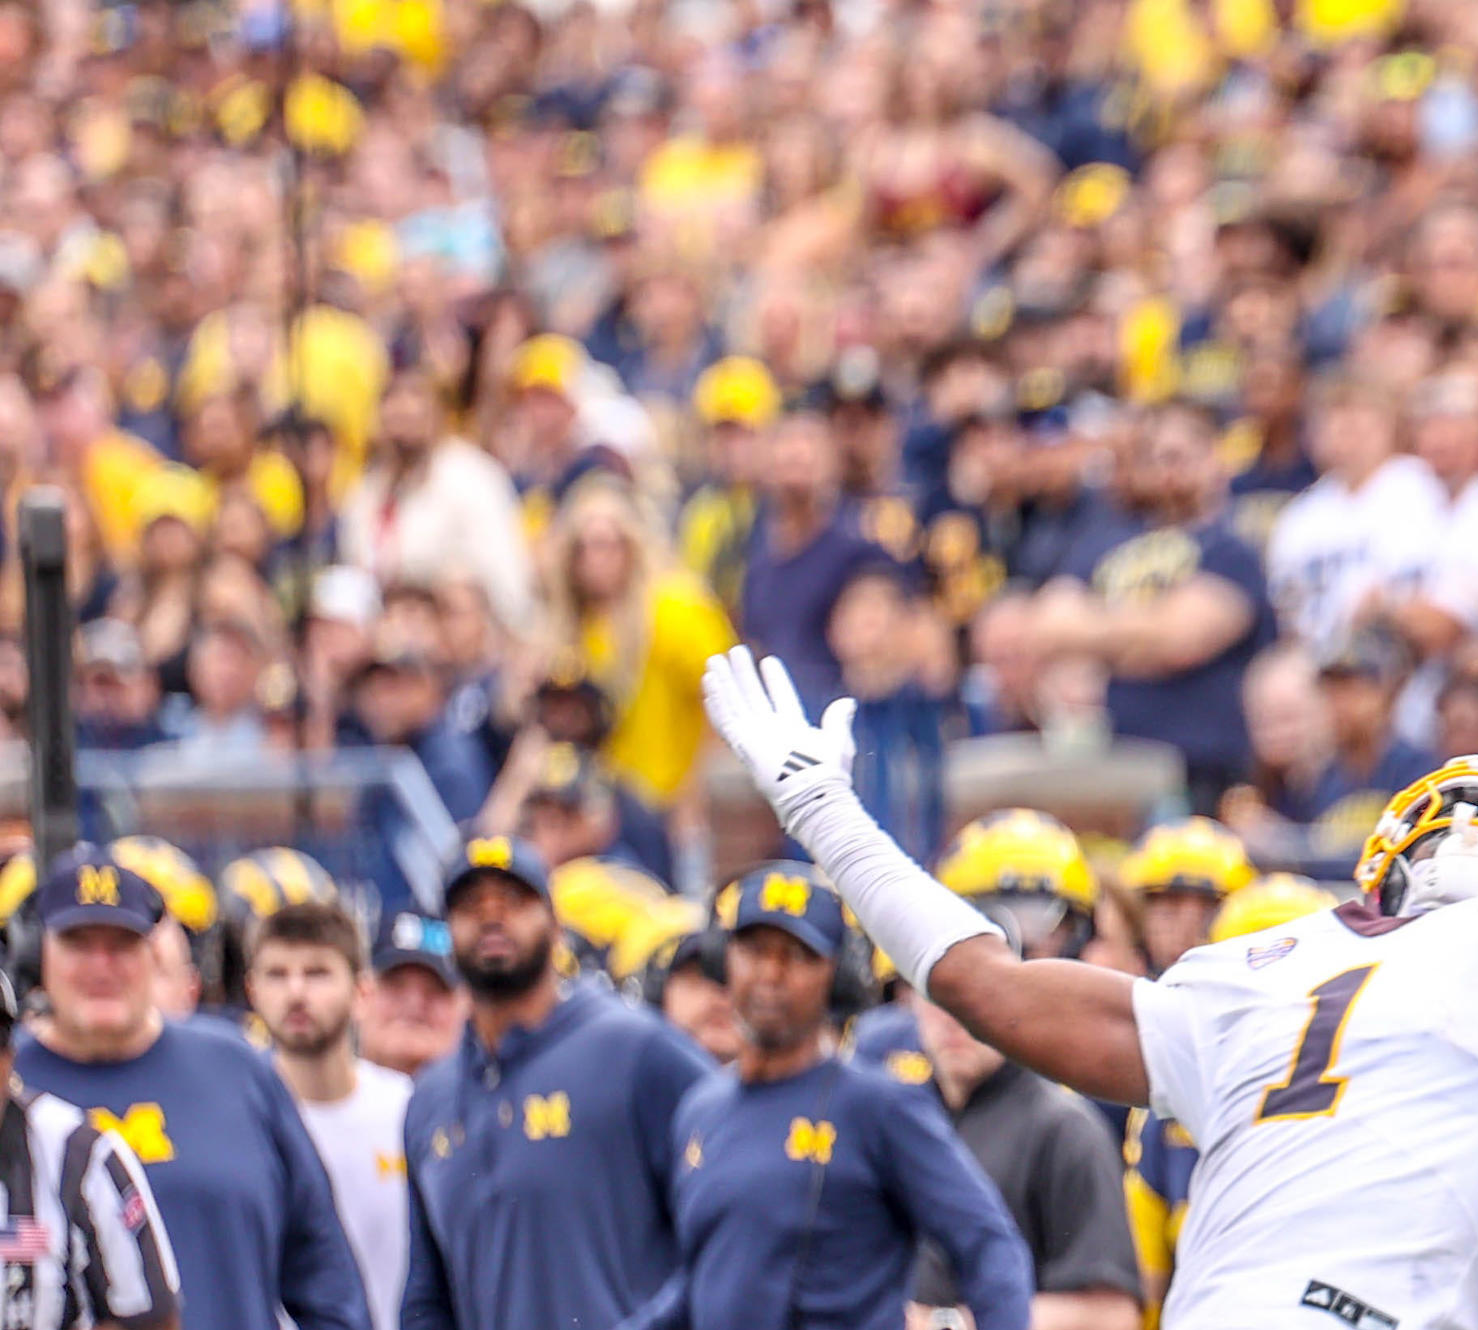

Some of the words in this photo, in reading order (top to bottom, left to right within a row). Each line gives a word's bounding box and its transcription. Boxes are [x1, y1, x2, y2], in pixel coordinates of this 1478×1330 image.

[76, 864, 121, 907] M
[1252, 959, 1383, 1127] 1
[784, 1115, 837, 1166] M
